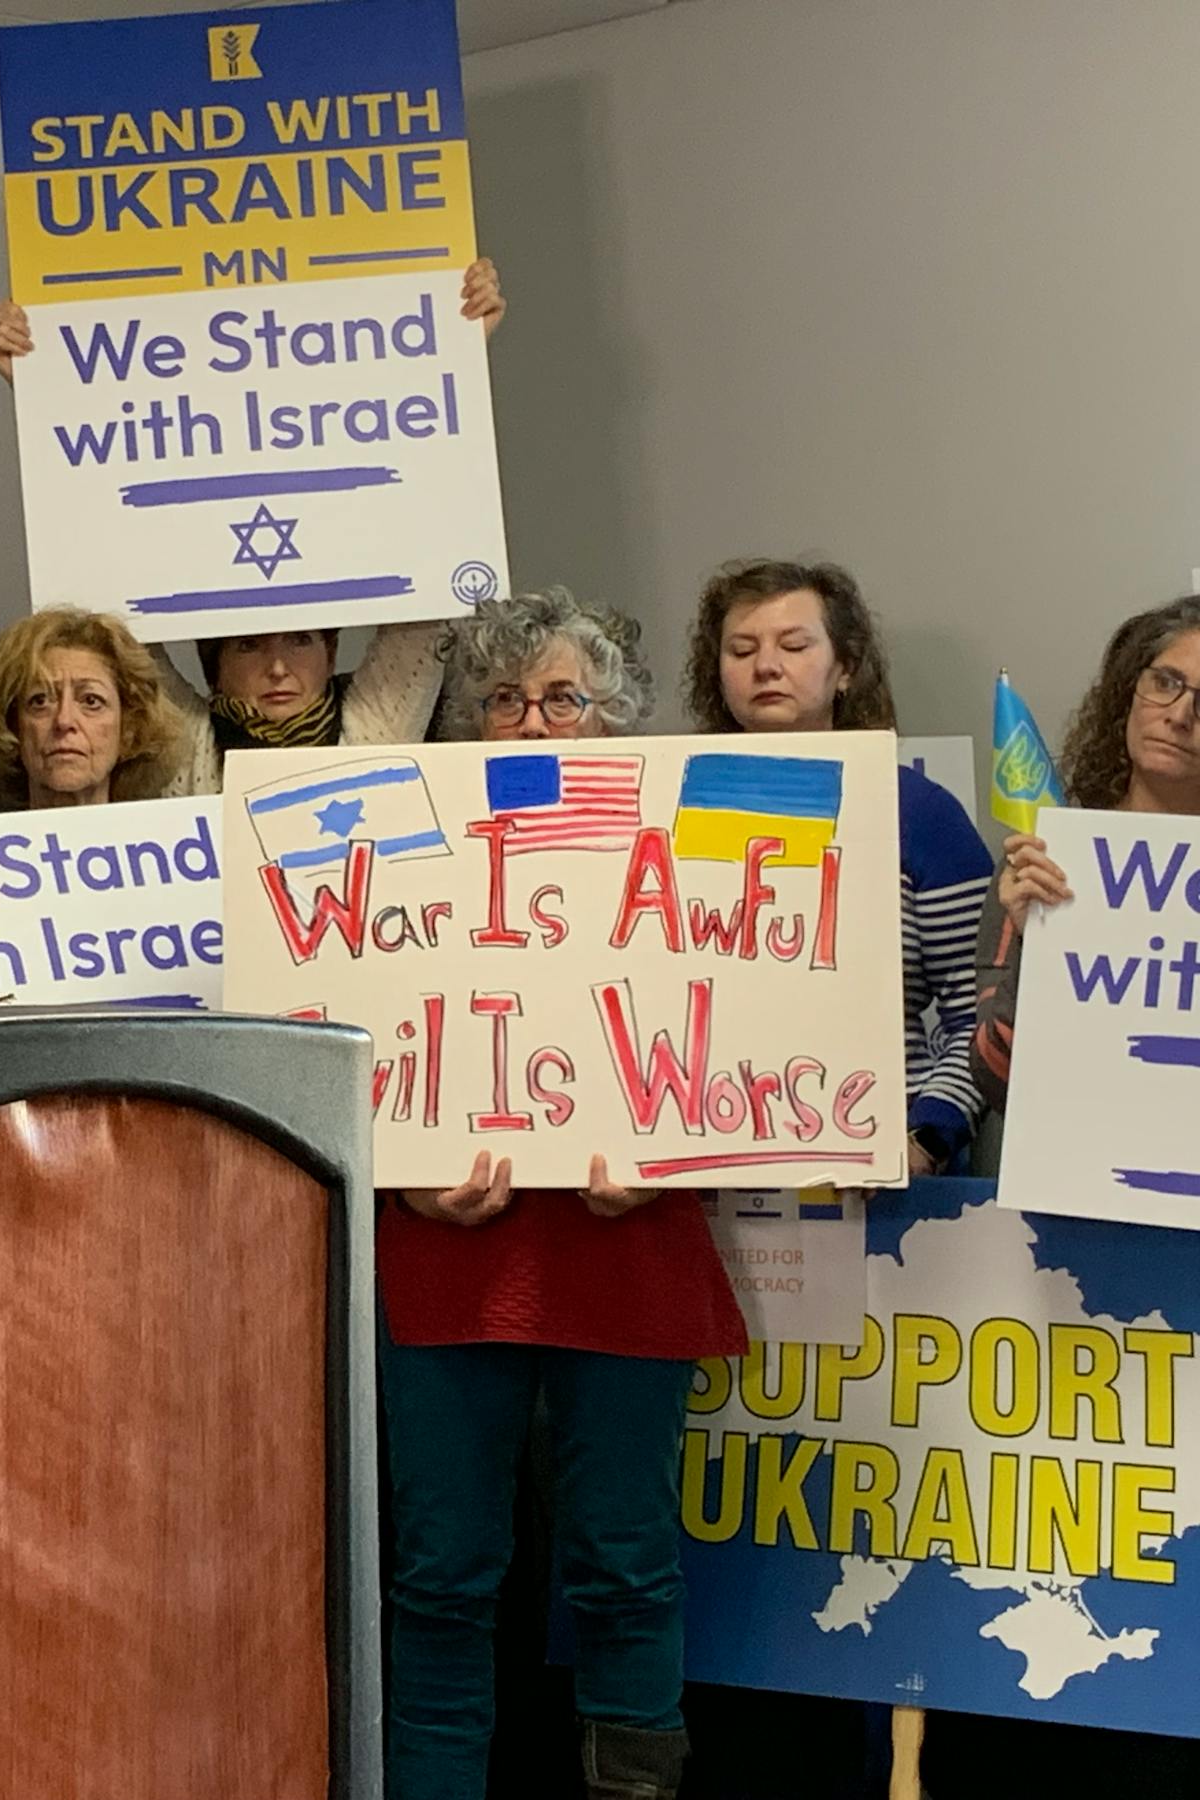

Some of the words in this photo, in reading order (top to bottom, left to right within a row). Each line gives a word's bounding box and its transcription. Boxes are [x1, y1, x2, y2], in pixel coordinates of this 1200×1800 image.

[31, 106, 246, 163] STAND
[266, 88, 442, 145] WITH
[35, 149, 446, 236] UKRAINE
[204, 247, 288, 286] MN
[60, 319, 186, 384] We
[208, 293, 438, 374] Stand
[54, 395, 223, 466] with
[245, 373, 460, 452] Israel
[258, 839, 451, 966] War
[464, 815, 571, 948] Is
[608, 827, 841, 970] Awful
[40, 917, 223, 982] Israe
[468, 990, 575, 1133] Is
[590, 978, 877, 1142] Worse
[773, 1249, 804, 1264] FOR
[680, 1428, 1176, 1585] UKRAINE
